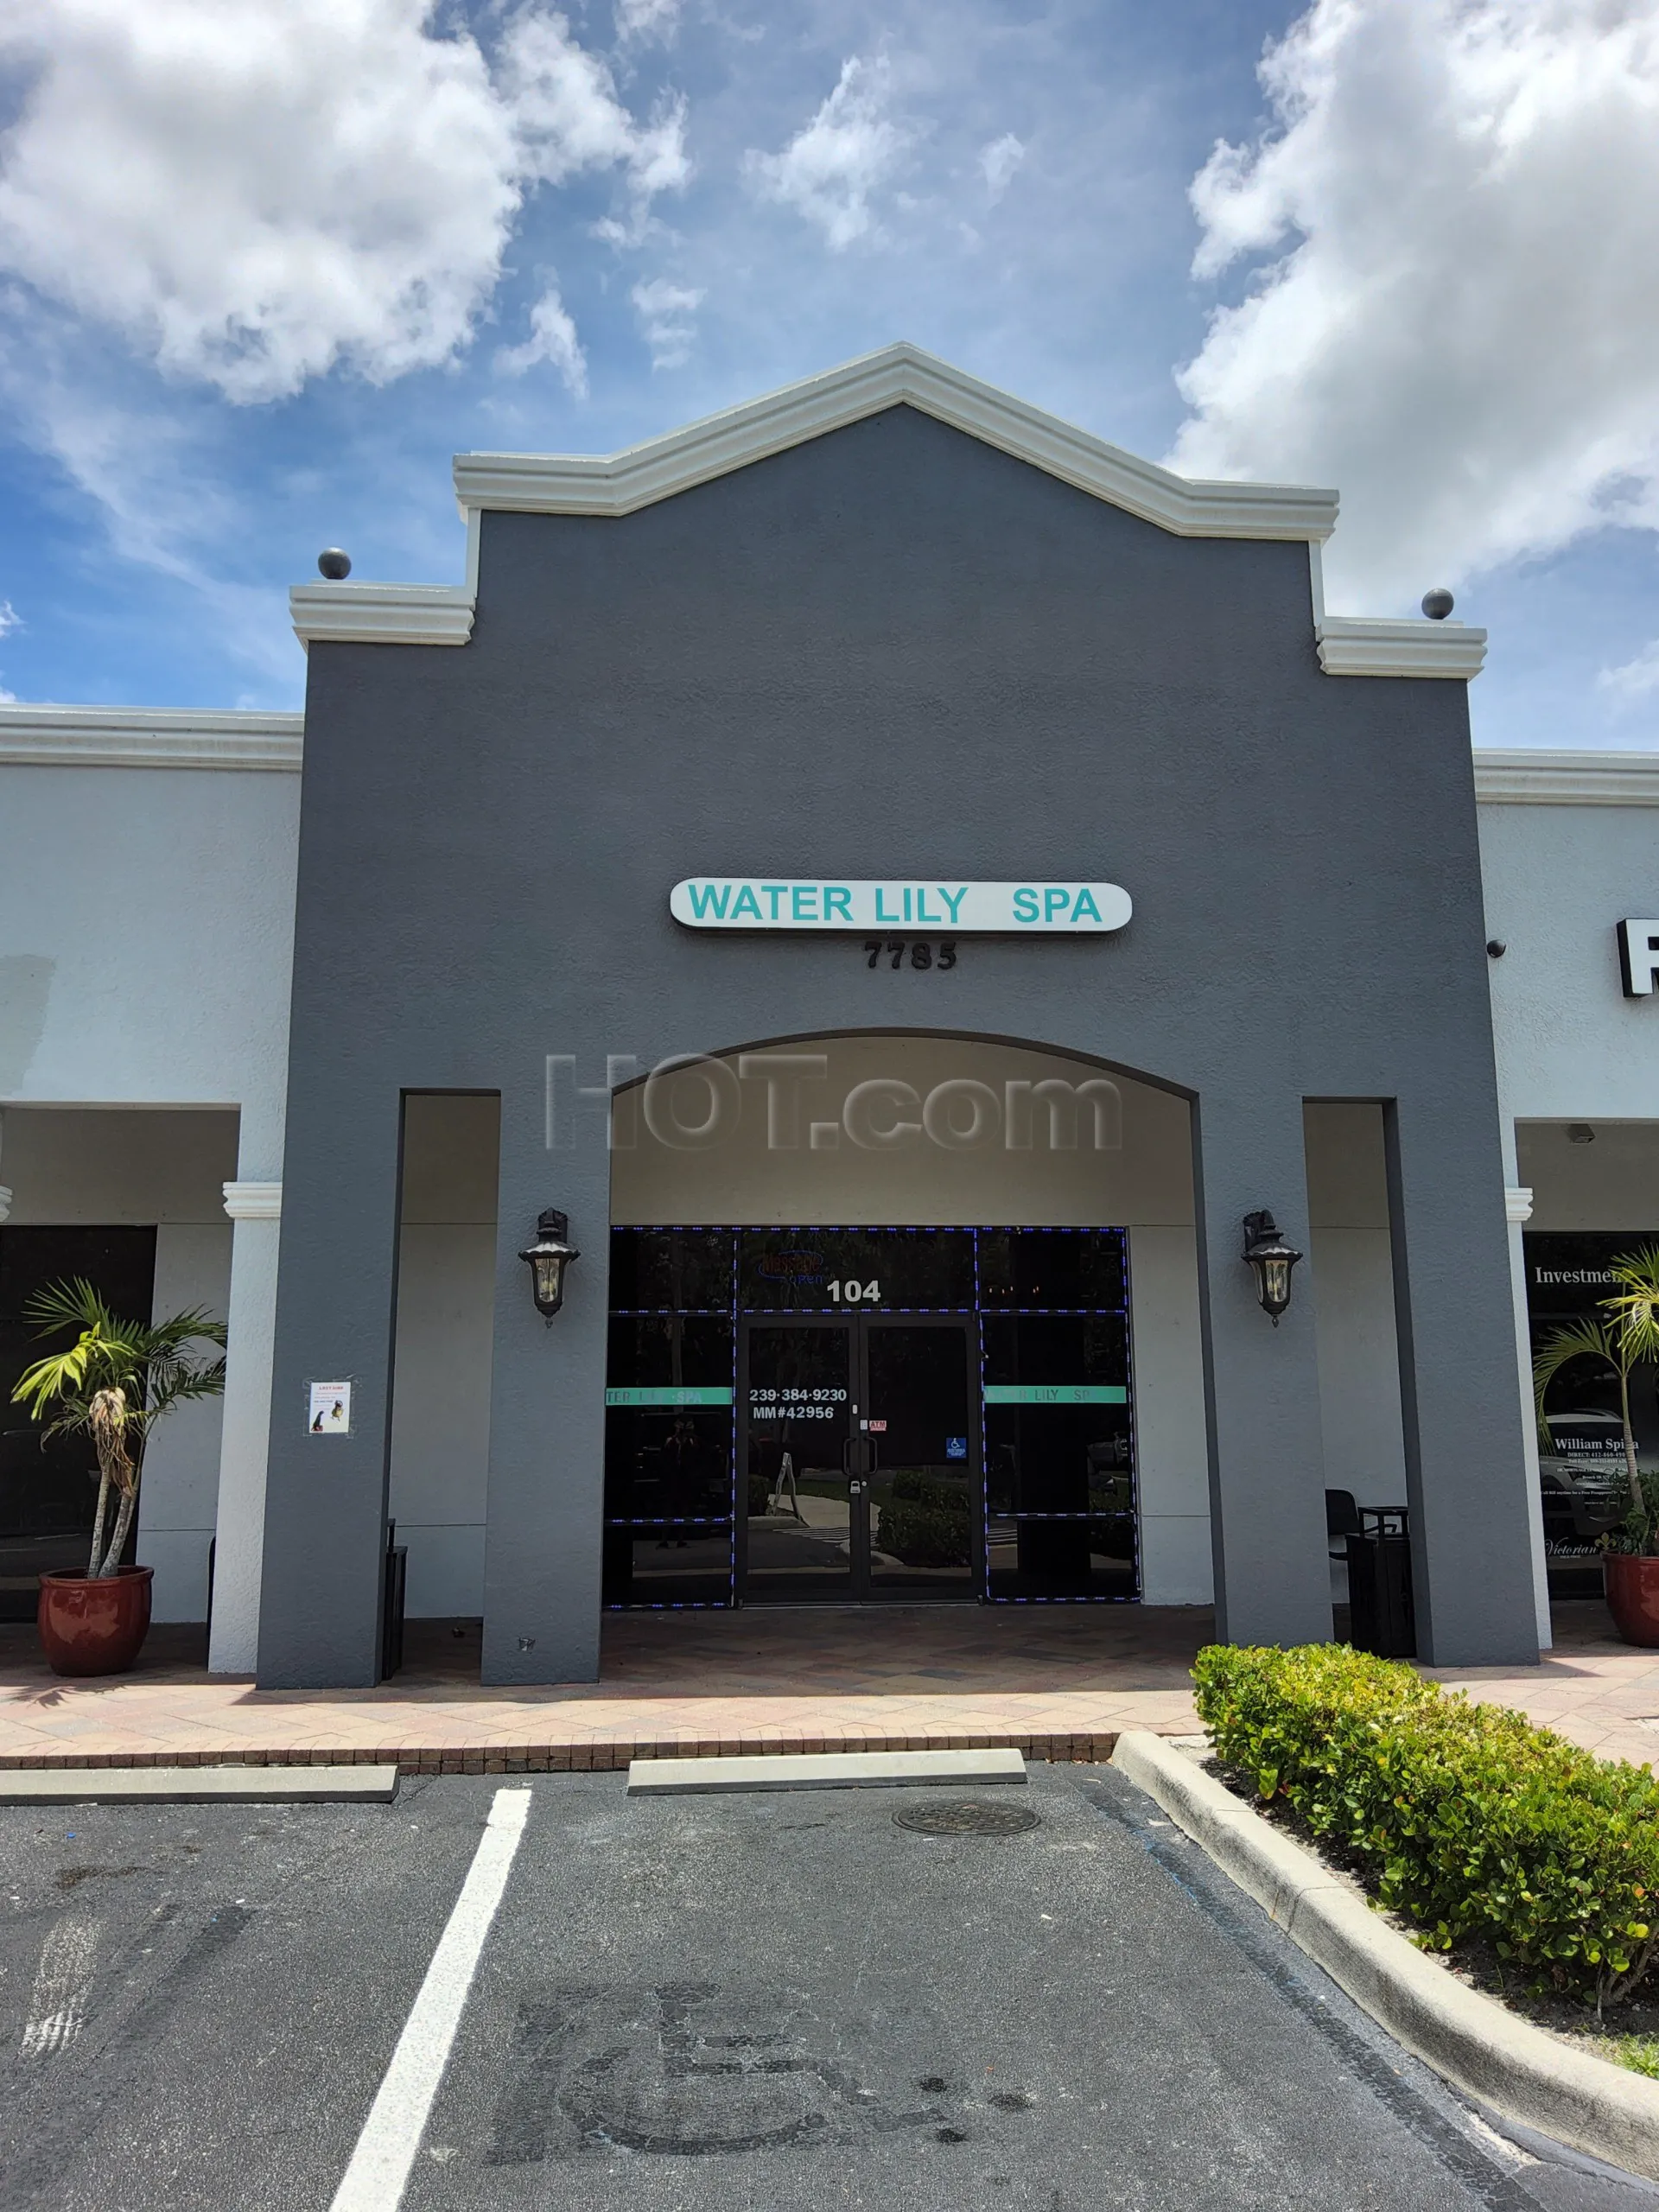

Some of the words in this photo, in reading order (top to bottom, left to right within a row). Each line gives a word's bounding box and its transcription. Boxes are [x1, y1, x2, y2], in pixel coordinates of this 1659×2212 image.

[688, 884, 854, 923] WATER
[874, 887, 969, 924] LILY
[1012, 888, 1103, 923] SPA
[864, 941, 957, 969] 7785
[827, 1280, 880, 1302] 104
[1035, 1389, 1059, 1401] LILY
[753, 1406, 835, 1420] MM#42956
[1555, 1439, 1602, 1450] William
[1544, 1537, 1598, 1556] Victorian
